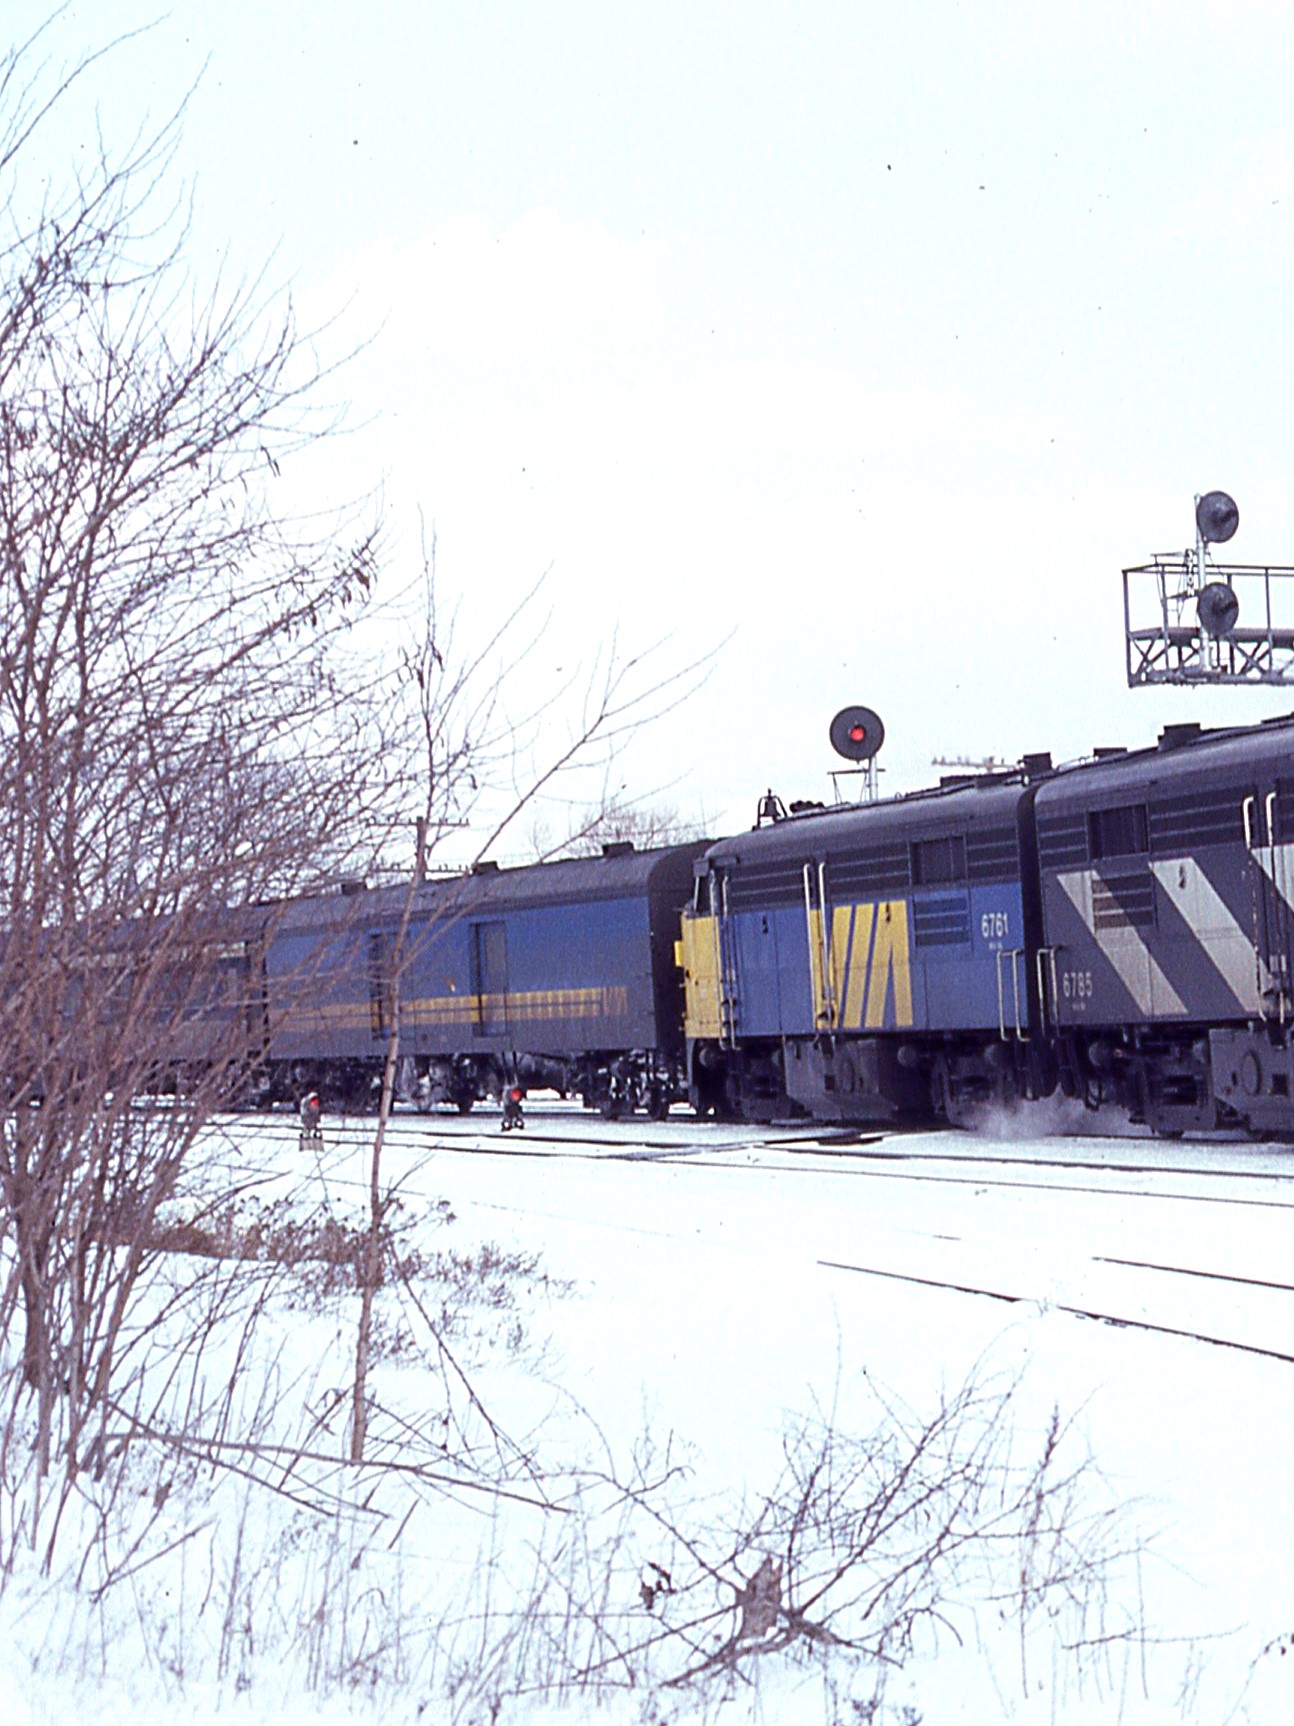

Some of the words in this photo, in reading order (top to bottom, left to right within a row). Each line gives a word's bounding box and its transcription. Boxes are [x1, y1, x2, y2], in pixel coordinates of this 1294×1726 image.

[982, 912, 1009, 938] 6761
[810, 900, 913, 1029] VIA
[1063, 972, 1092, 998] 6785
